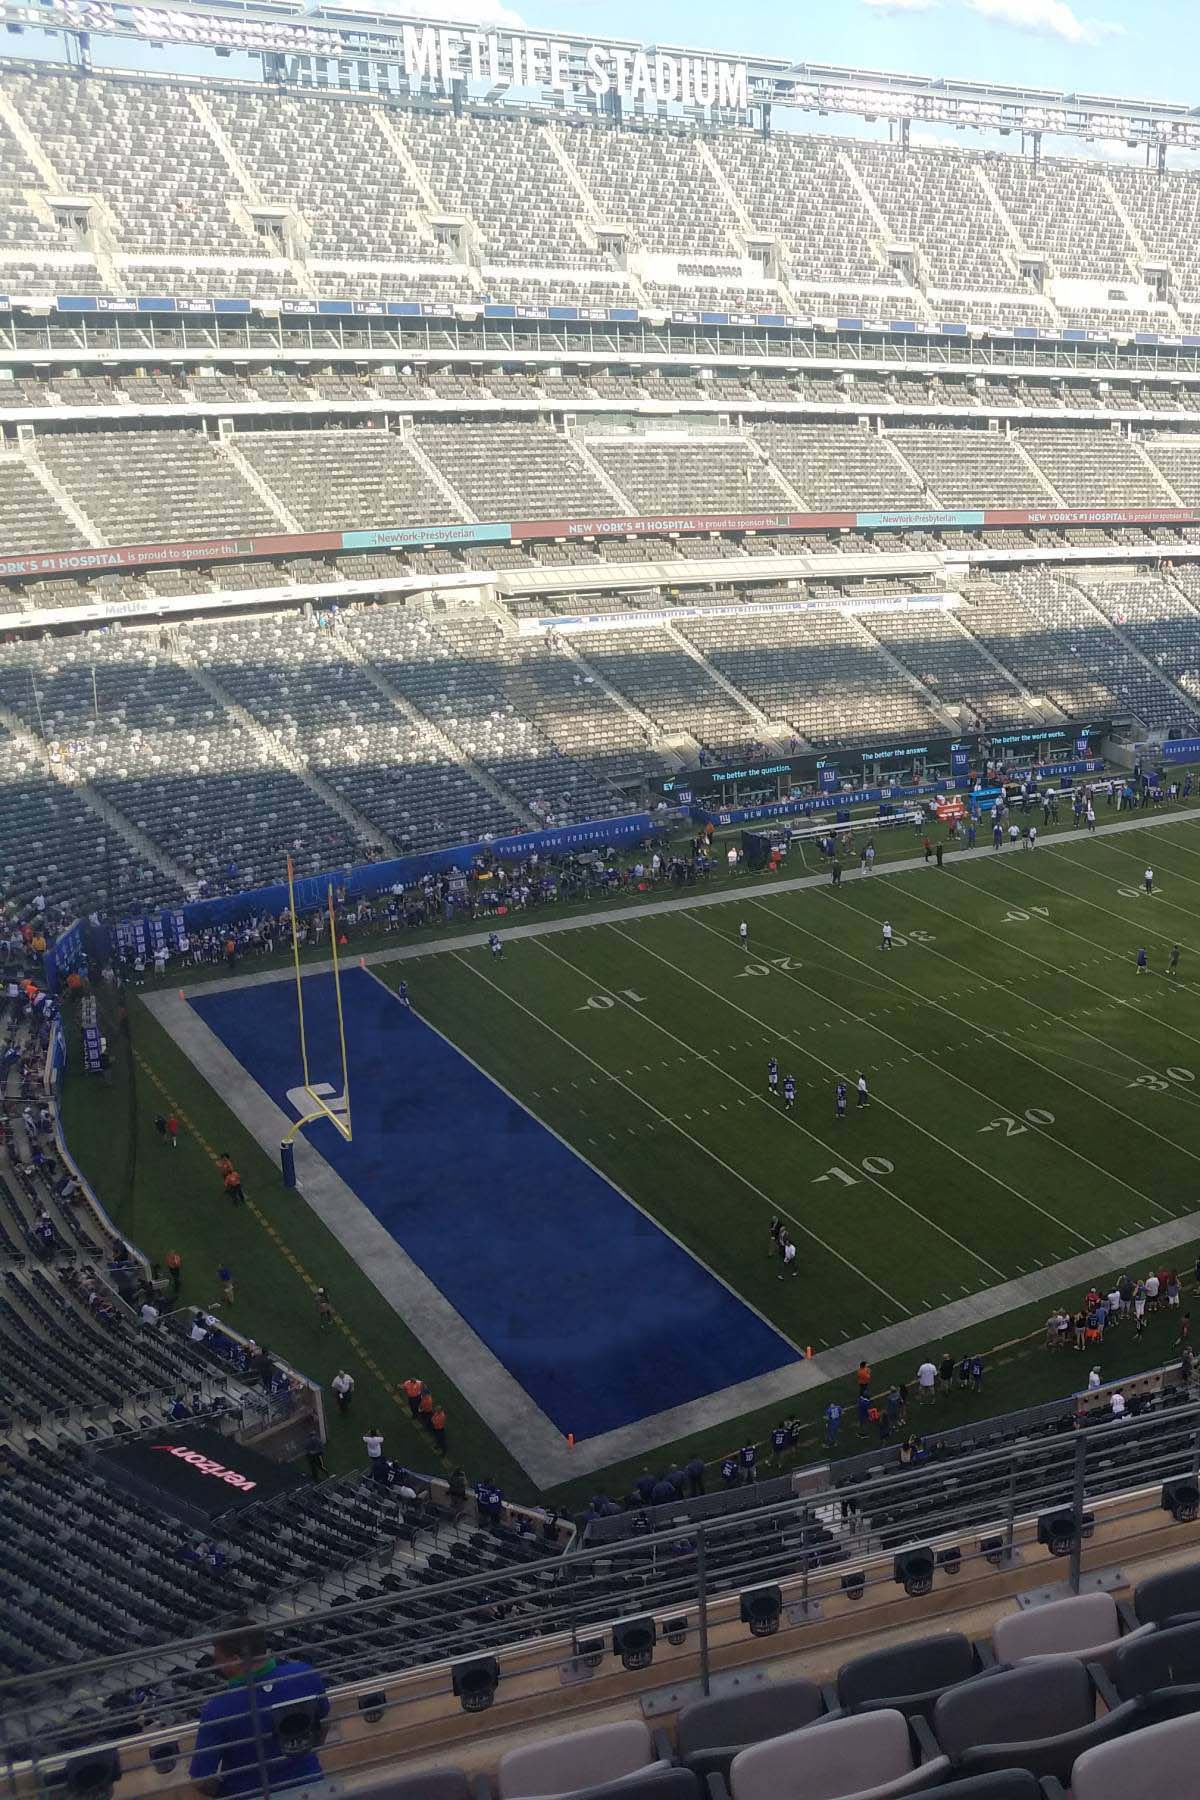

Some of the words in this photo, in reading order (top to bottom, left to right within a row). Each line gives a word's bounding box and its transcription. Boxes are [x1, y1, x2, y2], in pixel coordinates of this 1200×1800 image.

[402, 24, 571, 92] METLIFE
[586, 46, 748, 109] STADIUM
[882, 514, 956, 524] NewYork-Presbyterian
[1049, 513, 1078, 521] YORK'S
[1089, 512, 1127, 521] HOSPITAL
[568, 524, 592, 534] NEW
[596, 522, 632, 532] YORK'S
[648, 520, 696, 530] HOSPITAL
[705, 520, 727, 529] proud
[737, 519, 765, 528] sponsor
[377, 529, 475, 544] NewYork-Presbyterian
[59, 553, 124, 569] HOSPITAL
[128, 552, 136, 560] is
[138, 548, 168, 562] proud
[170, 549, 180, 558] to
[182, 546, 219, 559] sponsor
[105, 604, 149, 616] MetLife
[991, 737, 1002, 745] The
[1003, 735, 1020, 744] better
[1032, 732, 1047, 740] world
[1048, 732, 1066, 740] works.
[862, 752, 873, 761] The
[874, 750, 893, 760] better
[906, 746, 928, 756] answer.
[726, 770, 748, 779] better
[762, 764, 791, 775] question.
[816, 760, 826, 768] EY
[664, 783, 674, 791] EY
[744, 811, 761, 820] NEW
[768, 806, 788, 814] YORK
[840, 793, 870, 804] GIANTS
[1006, 906, 1050, 921] 40
[745, 957, 802, 977] 20
[587, 989, 647, 1009] 10
[1136, 1066, 1196, 1091] 30
[990, 1108, 1056, 1136] 20
[826, 1155, 894, 1187] 10
[170, 1446, 256, 1490] verizon
